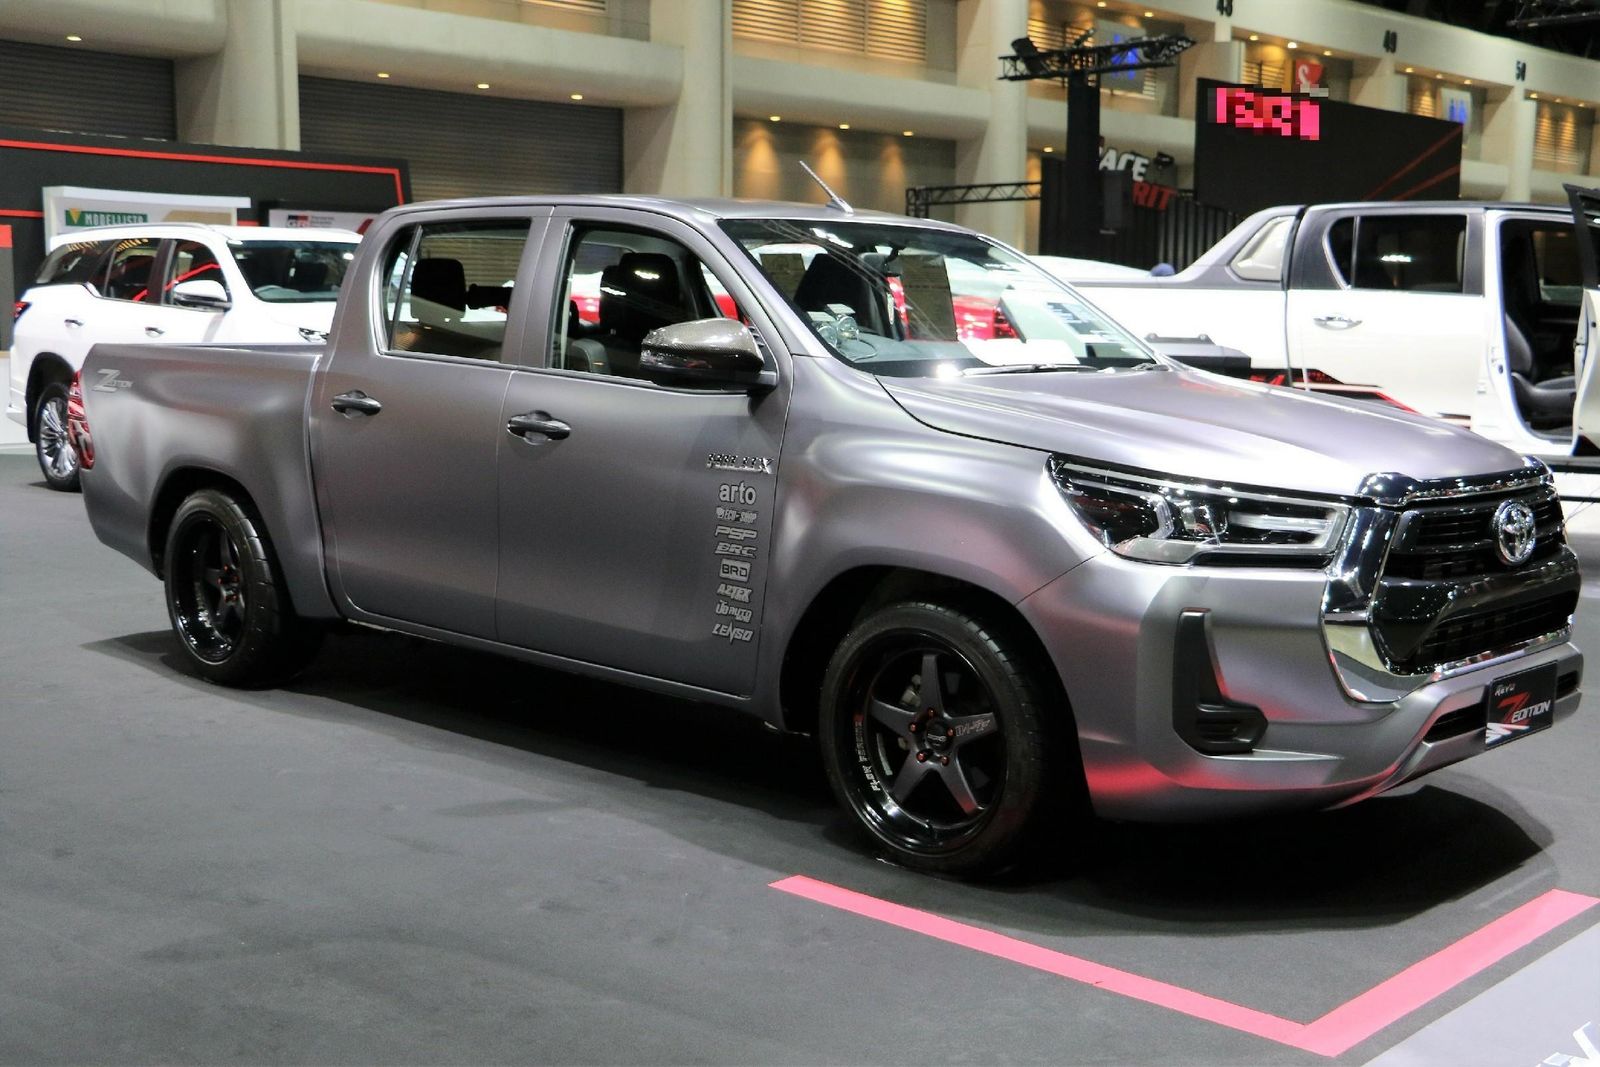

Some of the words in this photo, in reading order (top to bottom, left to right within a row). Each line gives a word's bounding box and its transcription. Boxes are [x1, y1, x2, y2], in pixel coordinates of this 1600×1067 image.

[1098, 147, 1149, 182] ACE
[719, 482, 756, 505] arto
[714, 525, 757, 540] PSP
[722, 563, 748, 577] BRD
[712, 622, 753, 642] LENSO
[1511, 700, 1551, 723] EDITION
